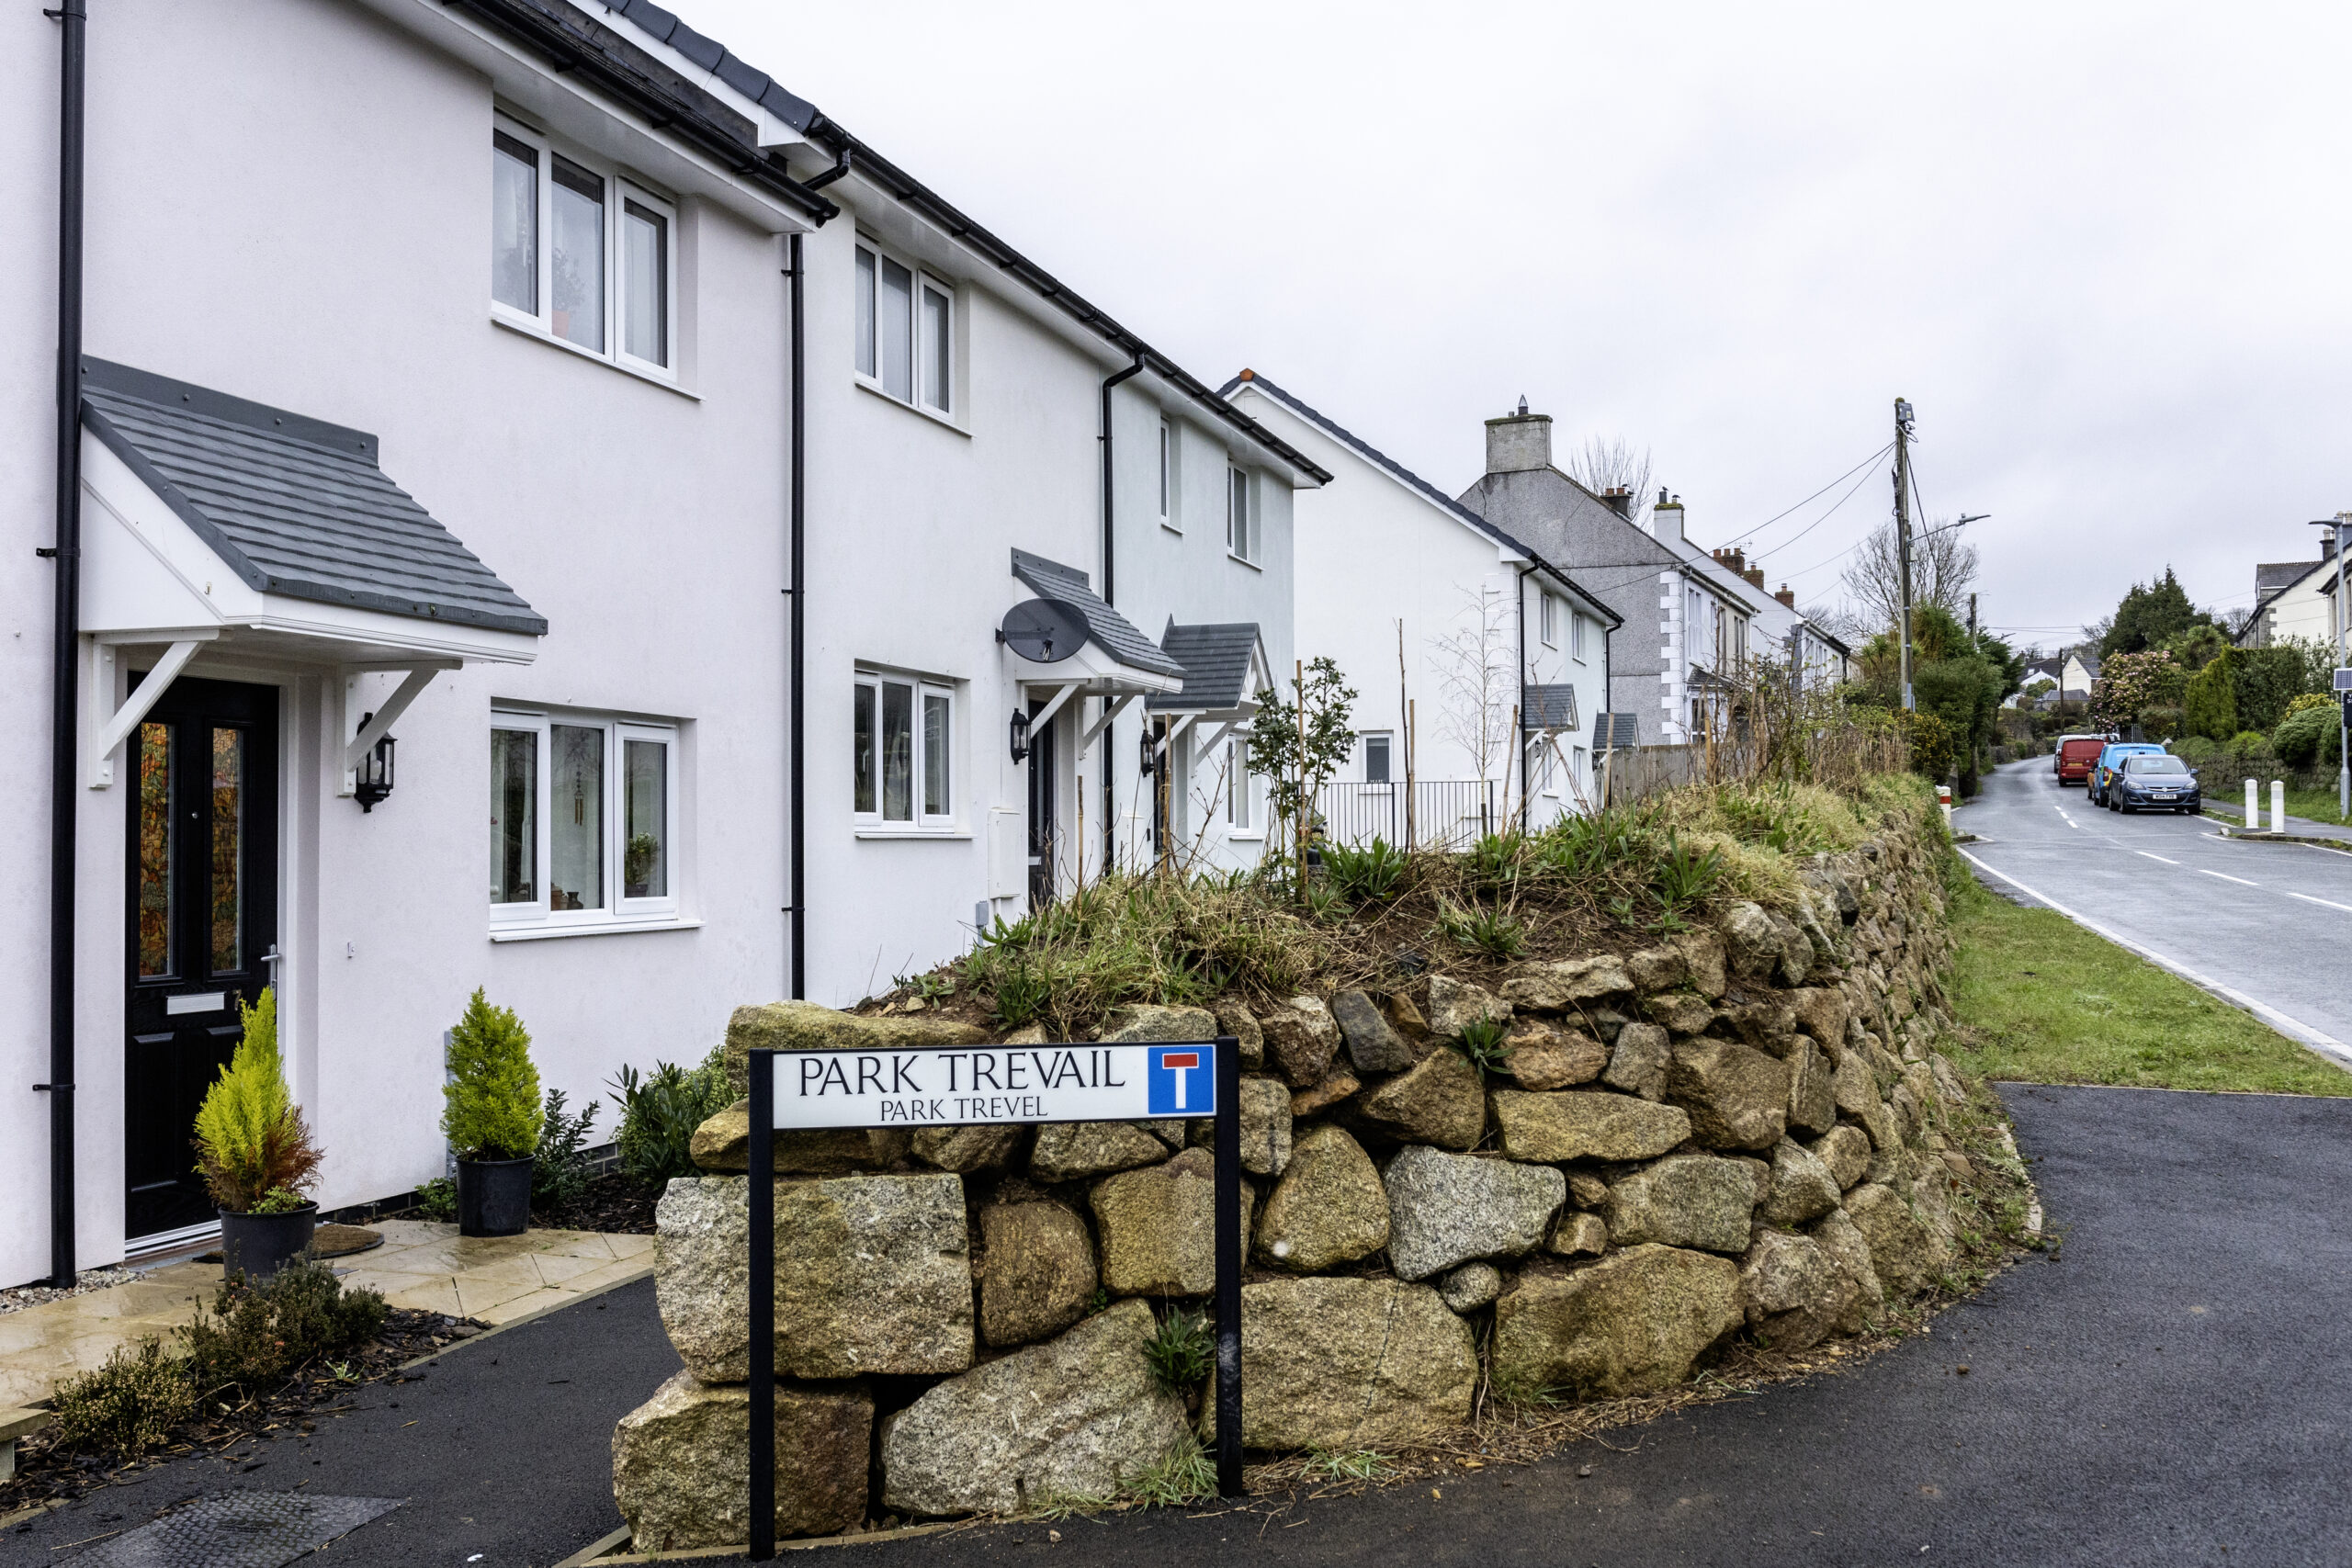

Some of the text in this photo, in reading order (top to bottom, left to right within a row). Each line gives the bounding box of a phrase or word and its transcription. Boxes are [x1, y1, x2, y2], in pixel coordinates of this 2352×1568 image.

[799, 1050, 1125, 1097] PARK TREVAIL
[880, 1096, 1048, 1122] PARK TREVEL
